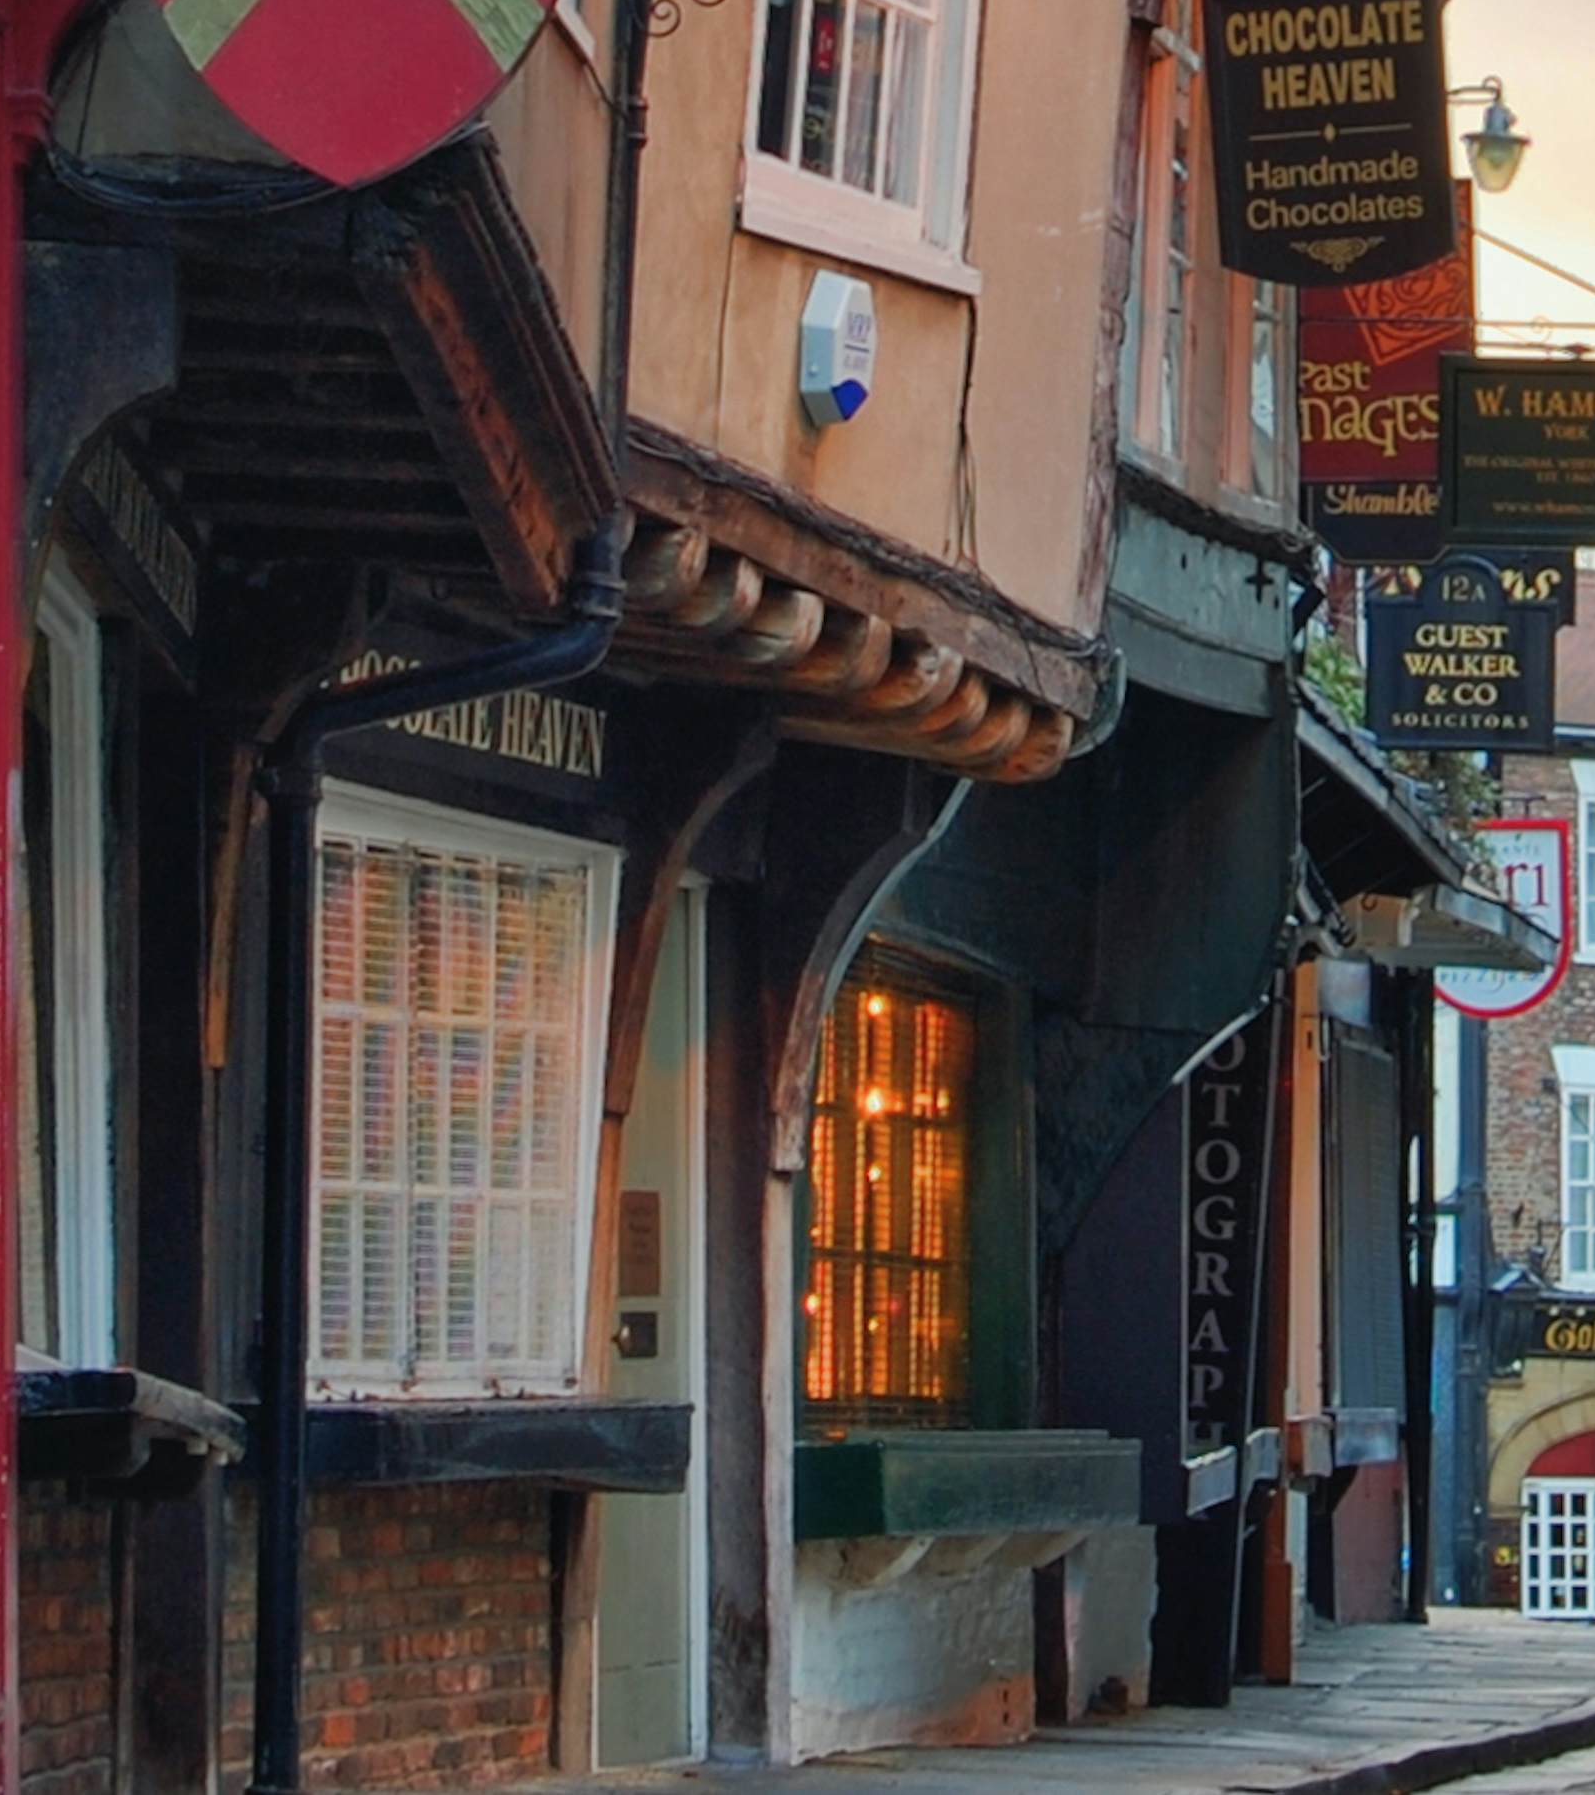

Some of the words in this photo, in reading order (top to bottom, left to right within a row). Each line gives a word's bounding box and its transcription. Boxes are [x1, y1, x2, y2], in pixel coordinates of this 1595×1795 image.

[1262, 58, 1396, 110] HEAVEN
[1244, 151, 1419, 192] Handmade
[1245, 190, 1424, 231] Chocolates
[1474, 384, 1512, 417] W.
[1323, 484, 1443, 516] Shamble
[1415, 623, 1510, 648] GUEST
[1403, 652, 1521, 678] WALKER
[1424, 683, 1448, 706] &
[1453, 682, 1499, 706] CO
[498, 689, 606, 779] HEAVEN
[1391, 711, 1530, 729] SOLICITORS
